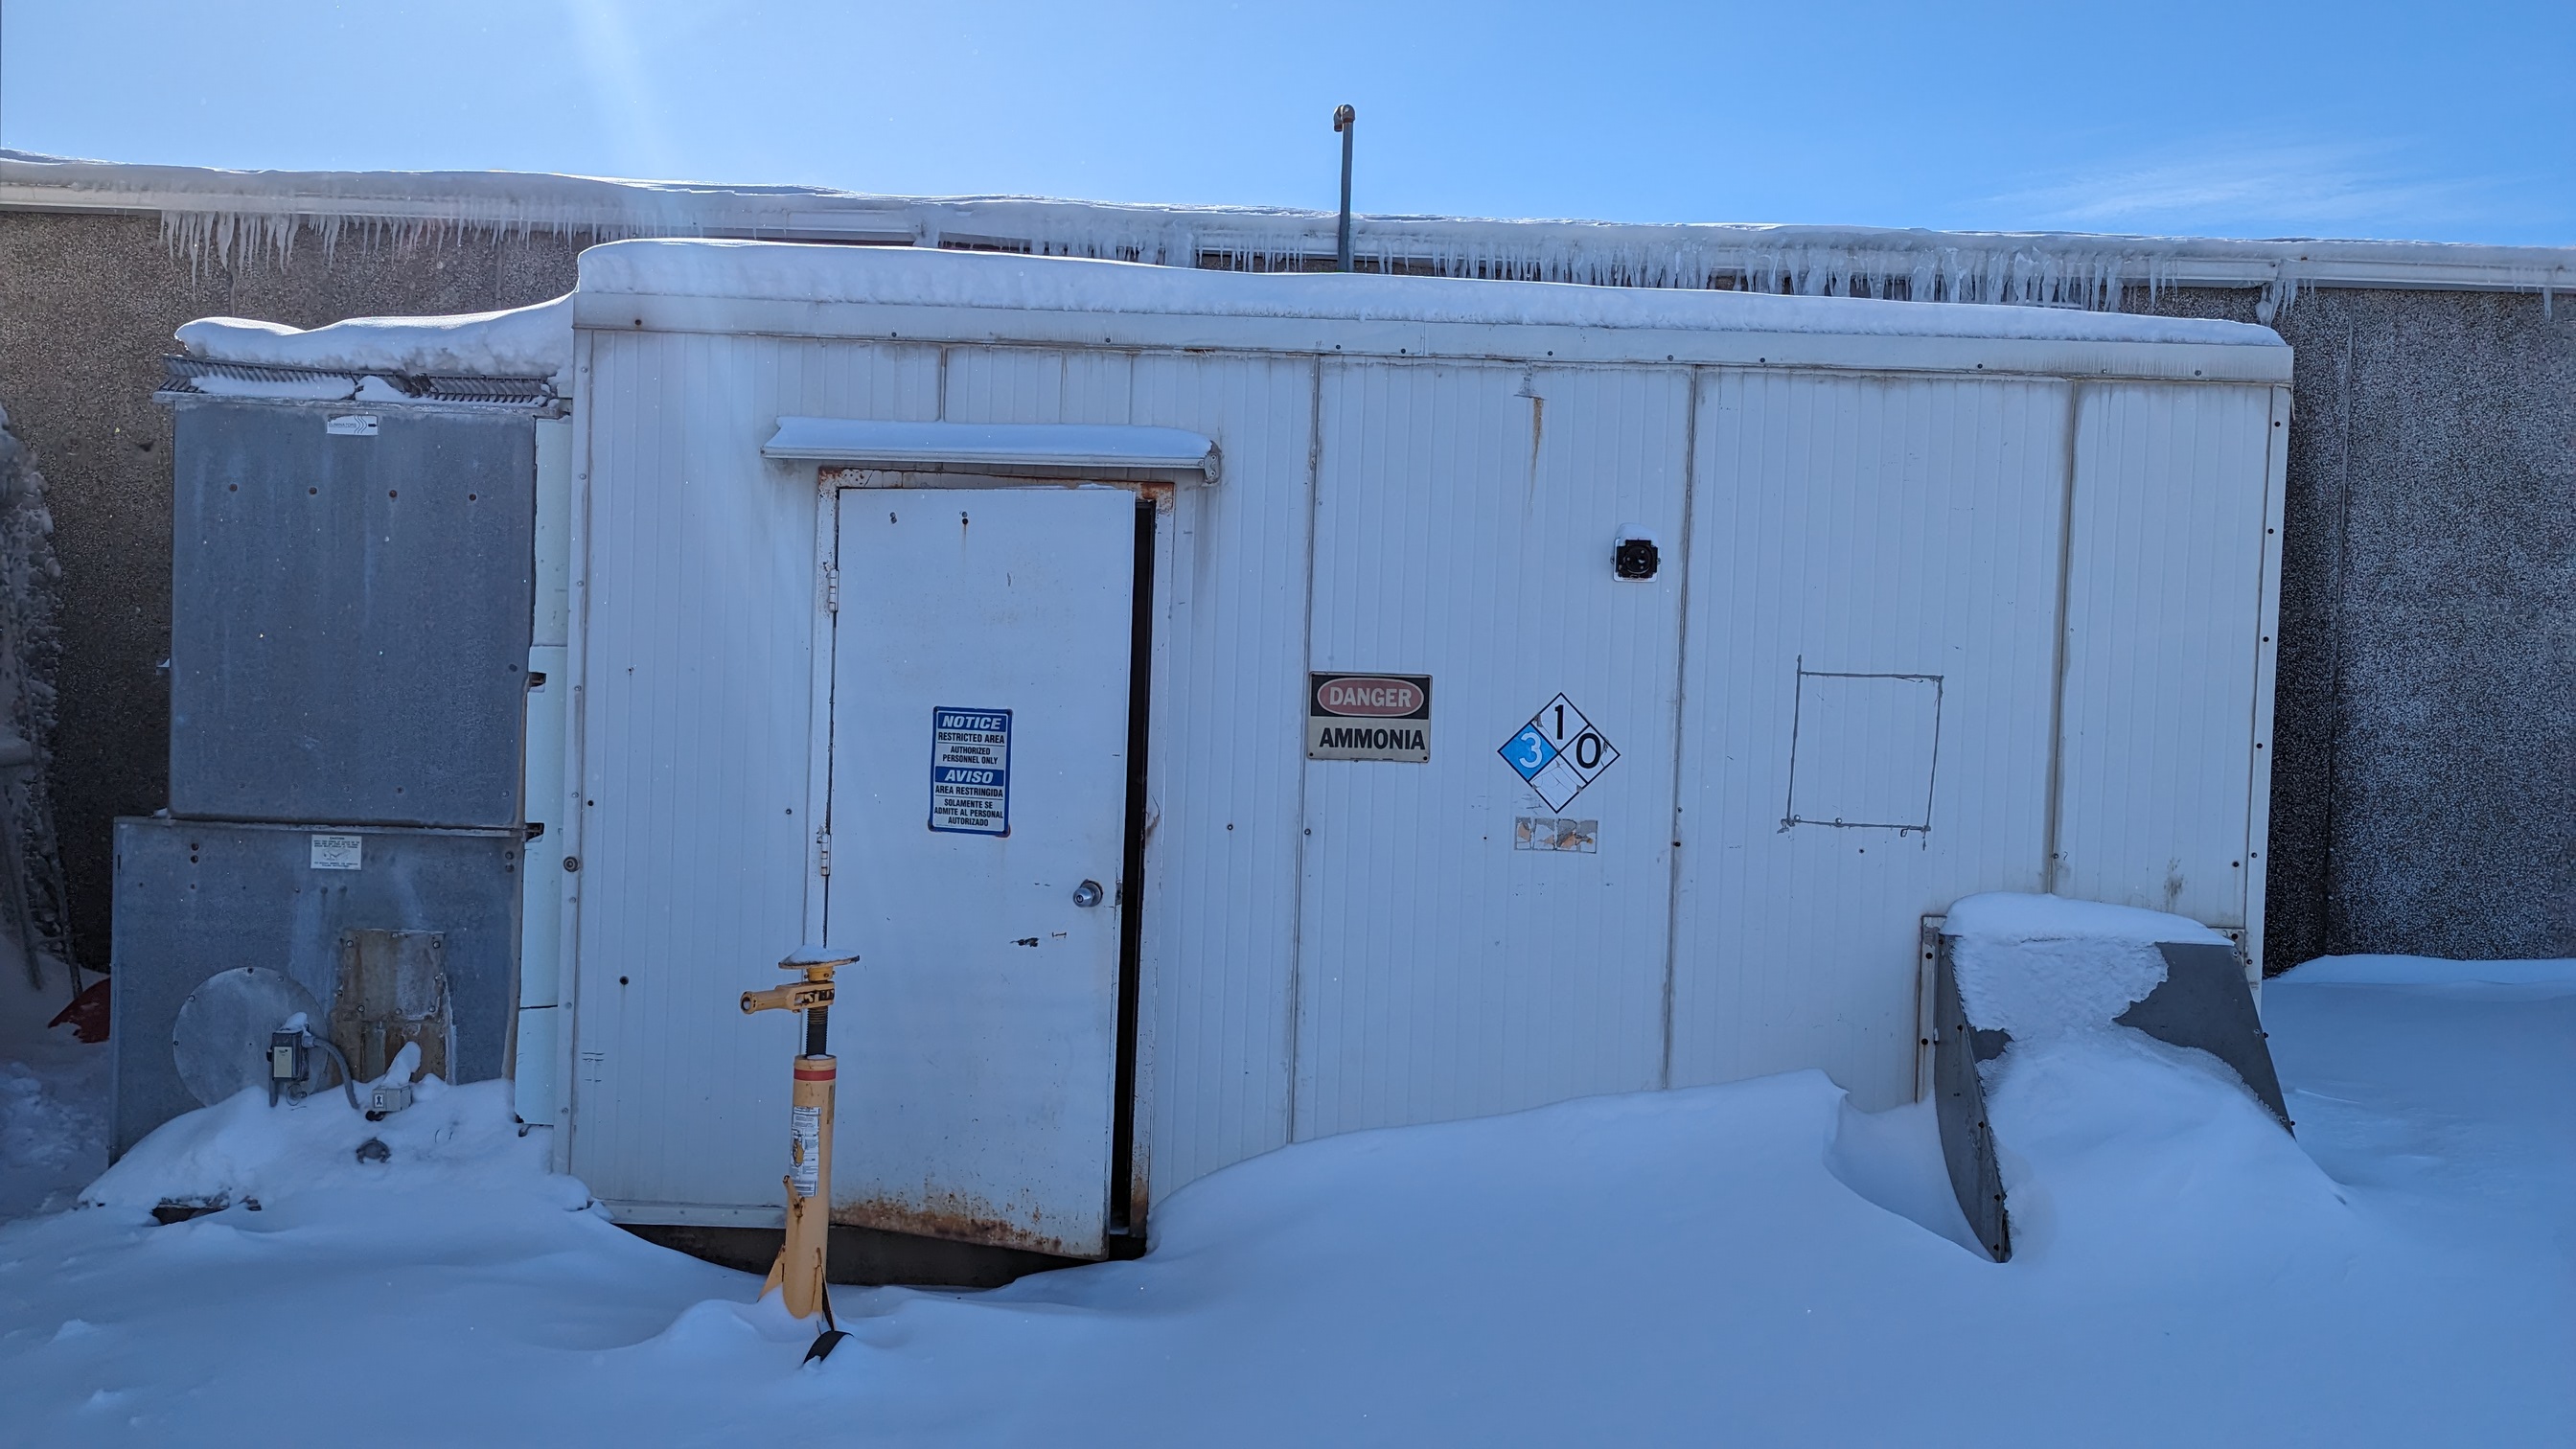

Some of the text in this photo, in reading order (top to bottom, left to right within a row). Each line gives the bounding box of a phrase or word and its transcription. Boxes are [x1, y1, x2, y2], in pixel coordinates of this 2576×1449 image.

[1329, 686, 1412, 707] DANGER
[942, 715, 1002, 730] NOTICE
[1554, 704, 1564, 740] 1
[937, 731, 1005, 744] RESTRICTED AREA
[1319, 727, 1426, 750] AMMONIA
[950, 746, 991, 755] AUTHORIZED
[1519, 731, 1601, 770] 3 0
[942, 754, 999, 765] PERSONNEL ONLY
[944, 769, 994, 784] AVISO
[934, 785, 1003, 797] AREA RESTRINGIDA
[944, 798, 983, 809] SOLAMENTE
[933, 807, 958, 816] ADMITE
[970, 809, 1003, 818] PERSONAL
[948, 816, 989, 827] AUTORIZADO
